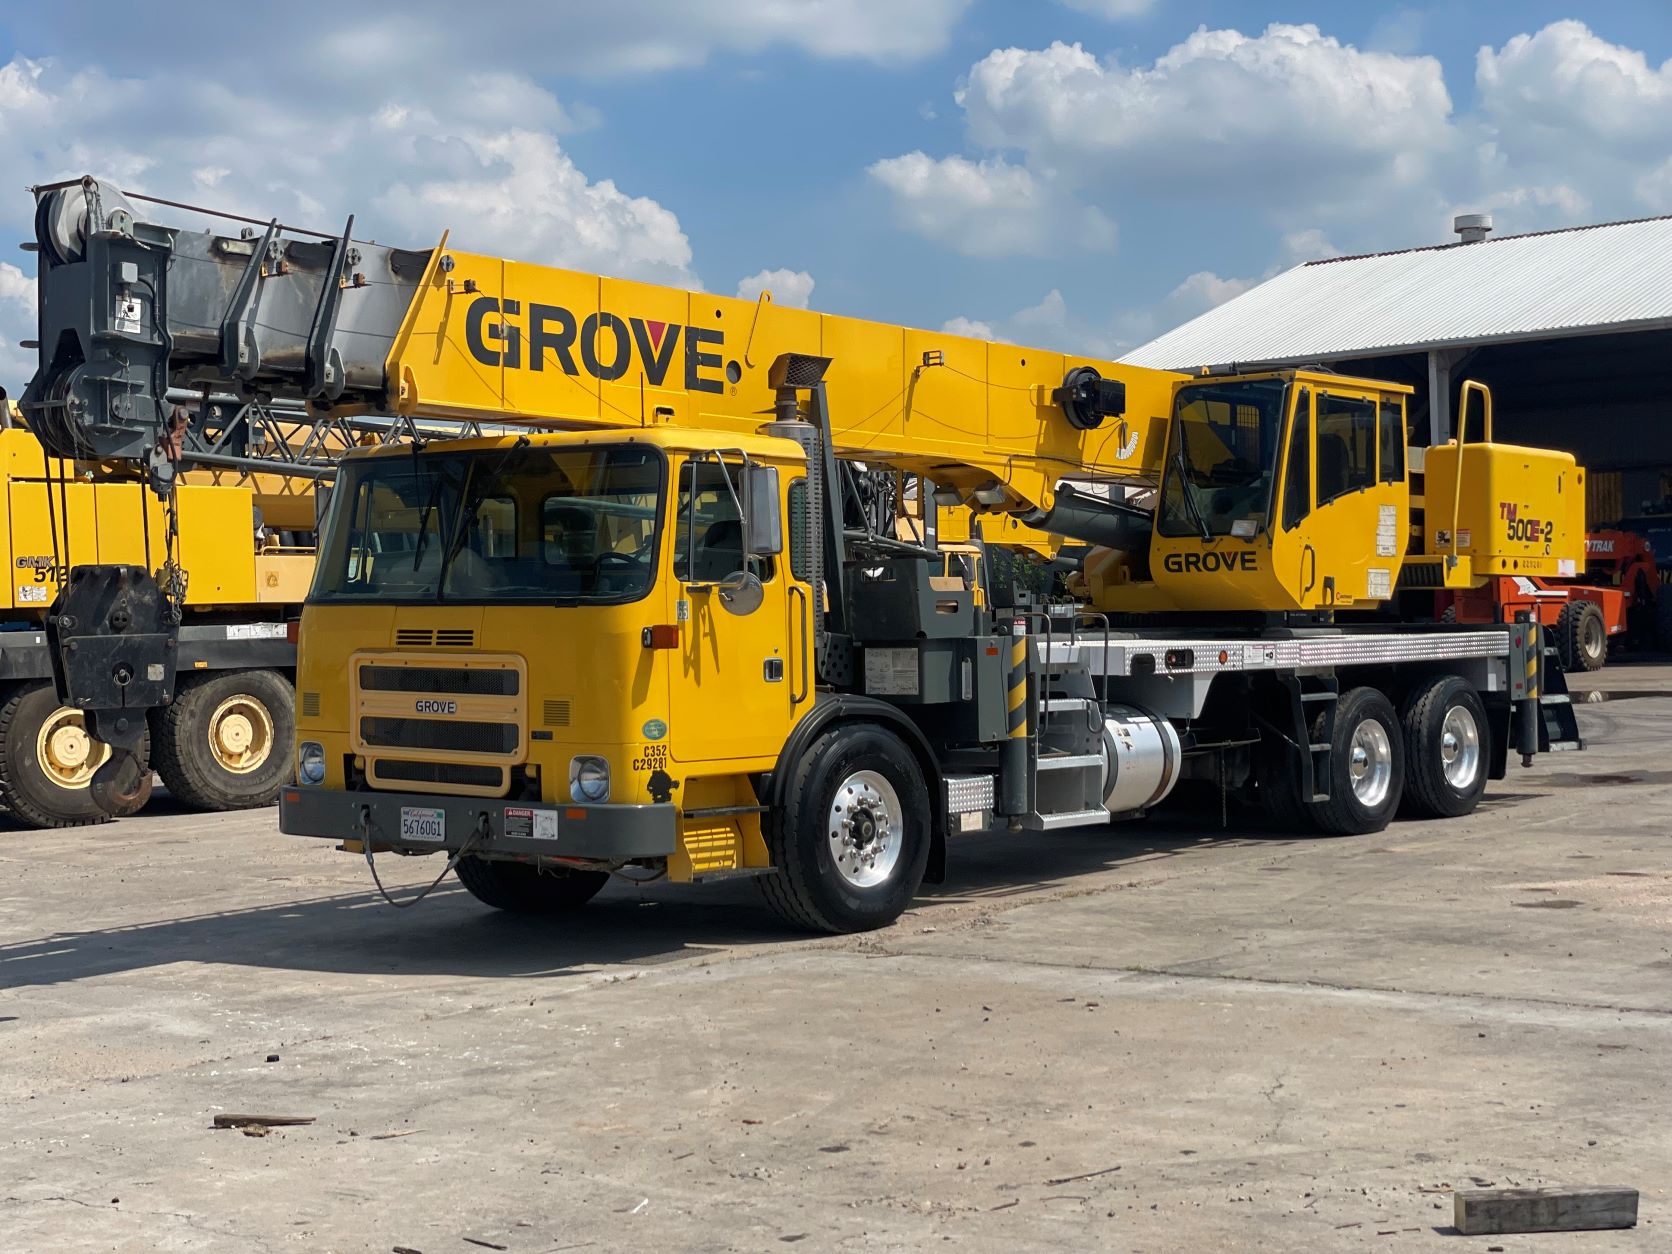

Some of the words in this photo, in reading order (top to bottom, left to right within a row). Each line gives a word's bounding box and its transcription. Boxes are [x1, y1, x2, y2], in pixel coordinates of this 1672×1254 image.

[465, 296, 724, 394] GROVE
[1500, 503, 1517, 520] TM
[1507, 518, 1553, 543] 500E-2
[1584, 539, 1615, 552] YTRAK
[16, 556, 55, 568] GMK
[1164, 551, 1258, 572] GROVE
[416, 701, 456, 713] GROVE
[644, 745, 667, 757] C352
[633, 757, 667, 771] C29281
[403, 819, 442, 836] 56760G1
